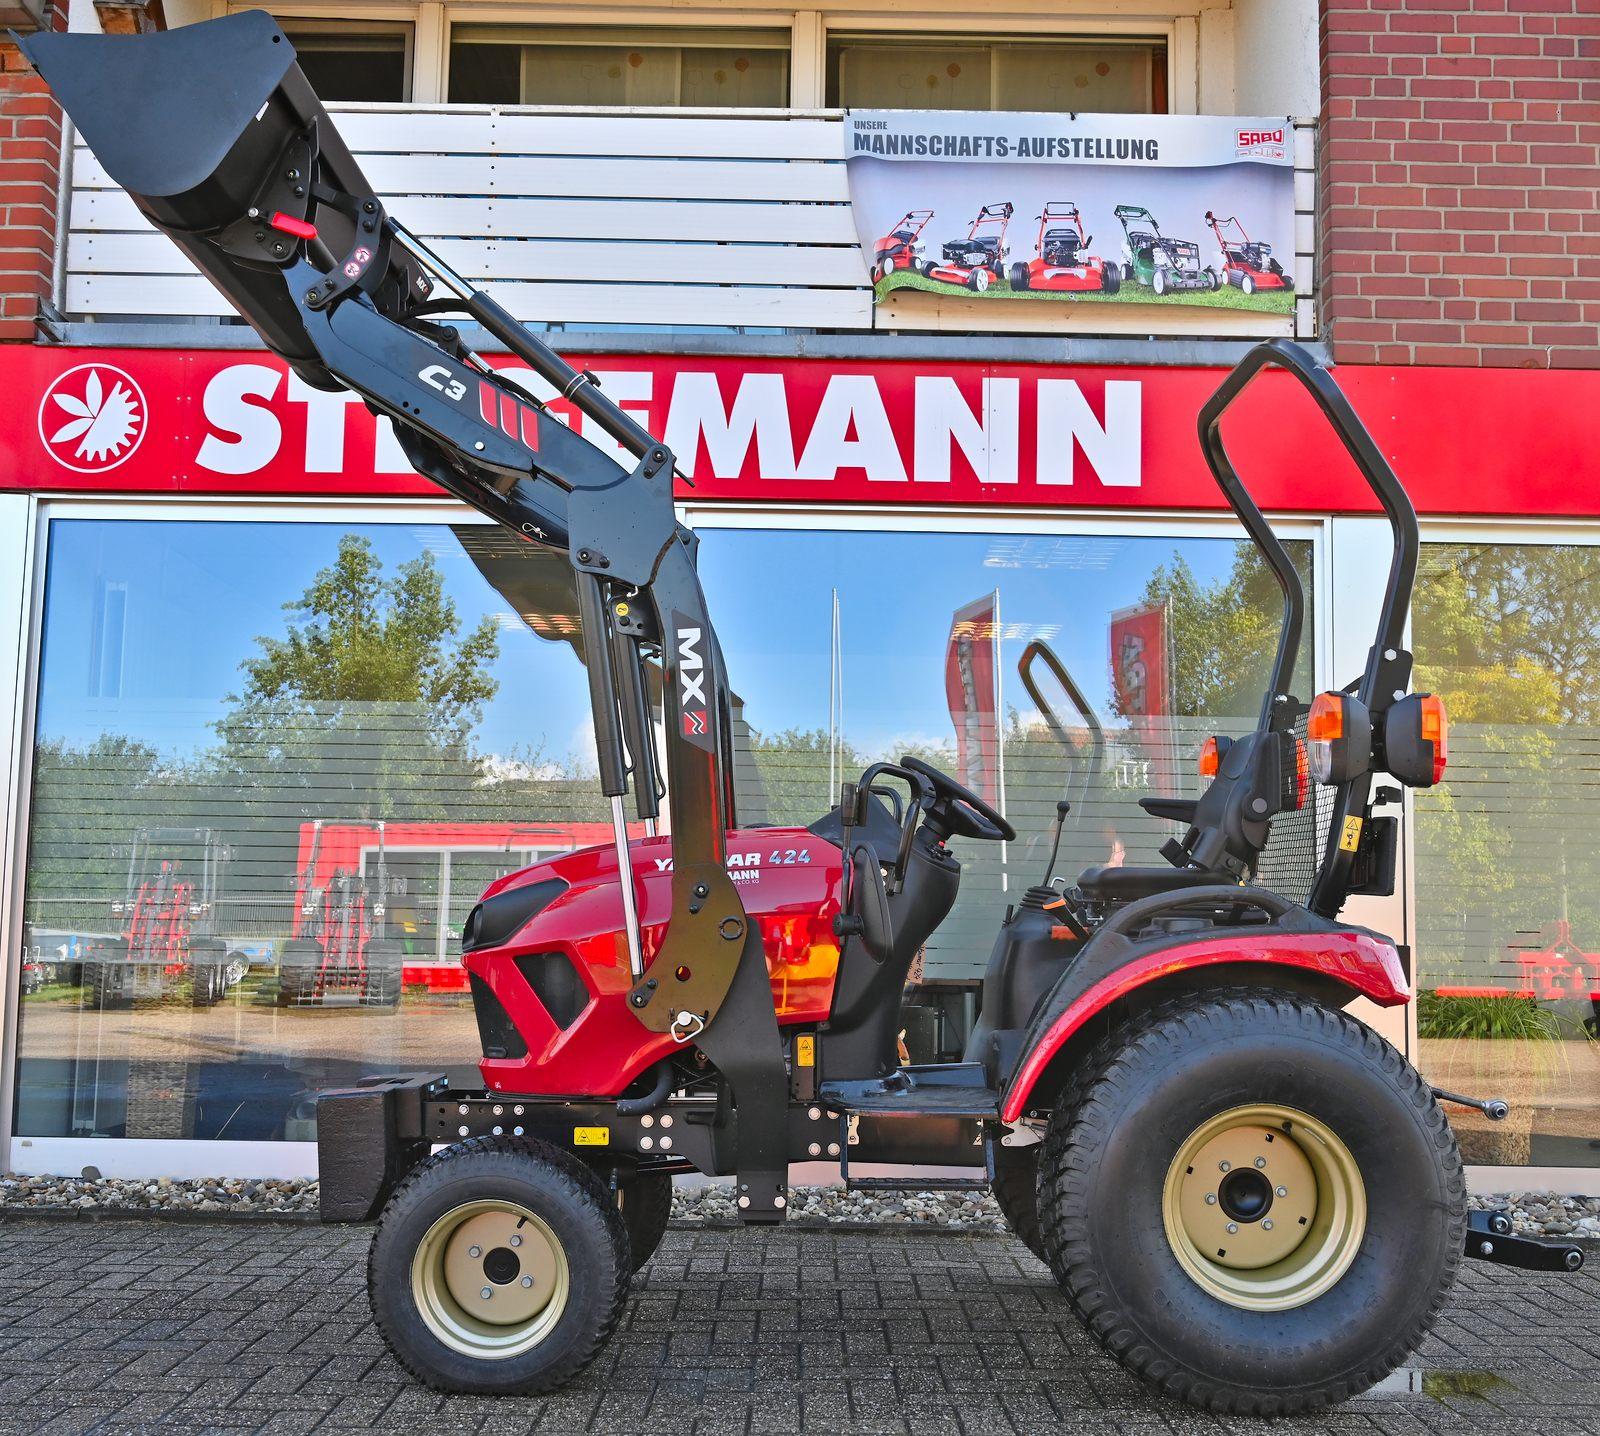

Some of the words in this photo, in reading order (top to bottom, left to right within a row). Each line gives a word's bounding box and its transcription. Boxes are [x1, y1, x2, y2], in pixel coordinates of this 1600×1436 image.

[854, 121, 887, 130] UNSERE
[853, 133, 1158, 160] MANNSCHAFTS-AUFSTELLUNG
[418, 365, 467, 401] C3
[195, 364, 1142, 487] STEMANN
[677, 628, 706, 706] MX
[653, 852, 761, 872] YAR
[769, 849, 811, 864] 424
